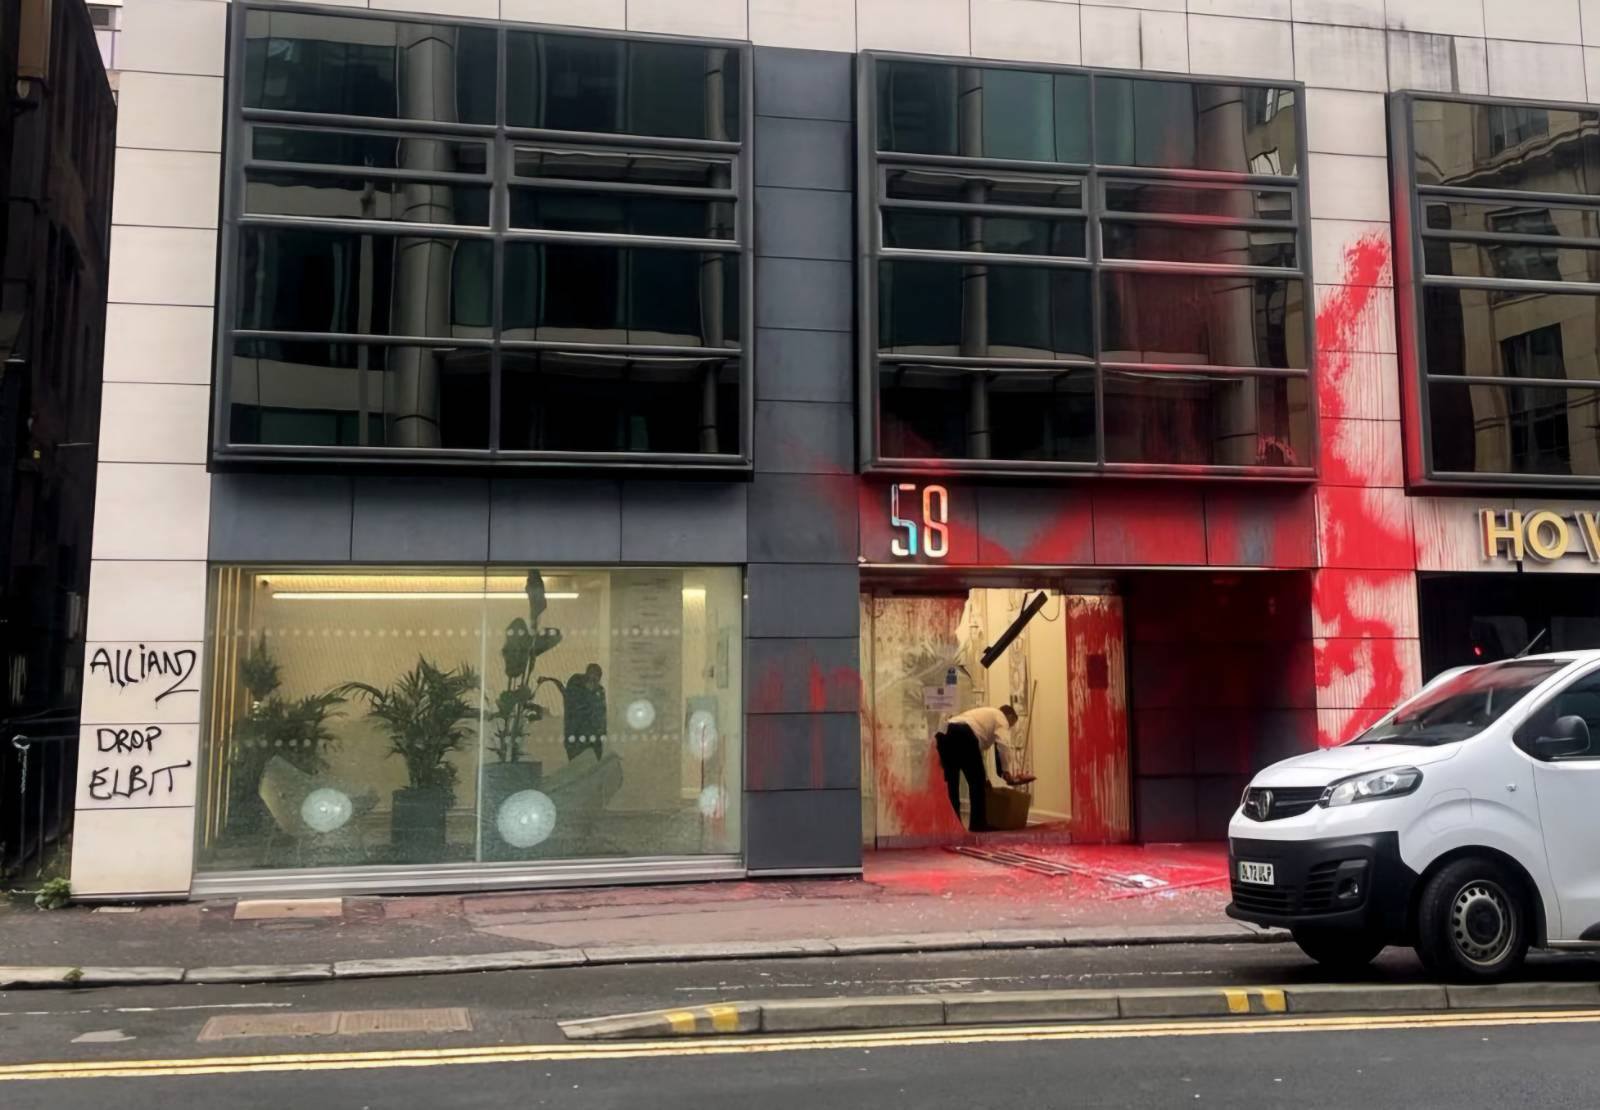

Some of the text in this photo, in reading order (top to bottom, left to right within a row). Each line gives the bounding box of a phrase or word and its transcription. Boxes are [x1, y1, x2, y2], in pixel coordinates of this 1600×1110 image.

[891, 484, 948, 557] 58
[97, 726, 162, 753] DROP
[89, 760, 191, 800] ELBIT
